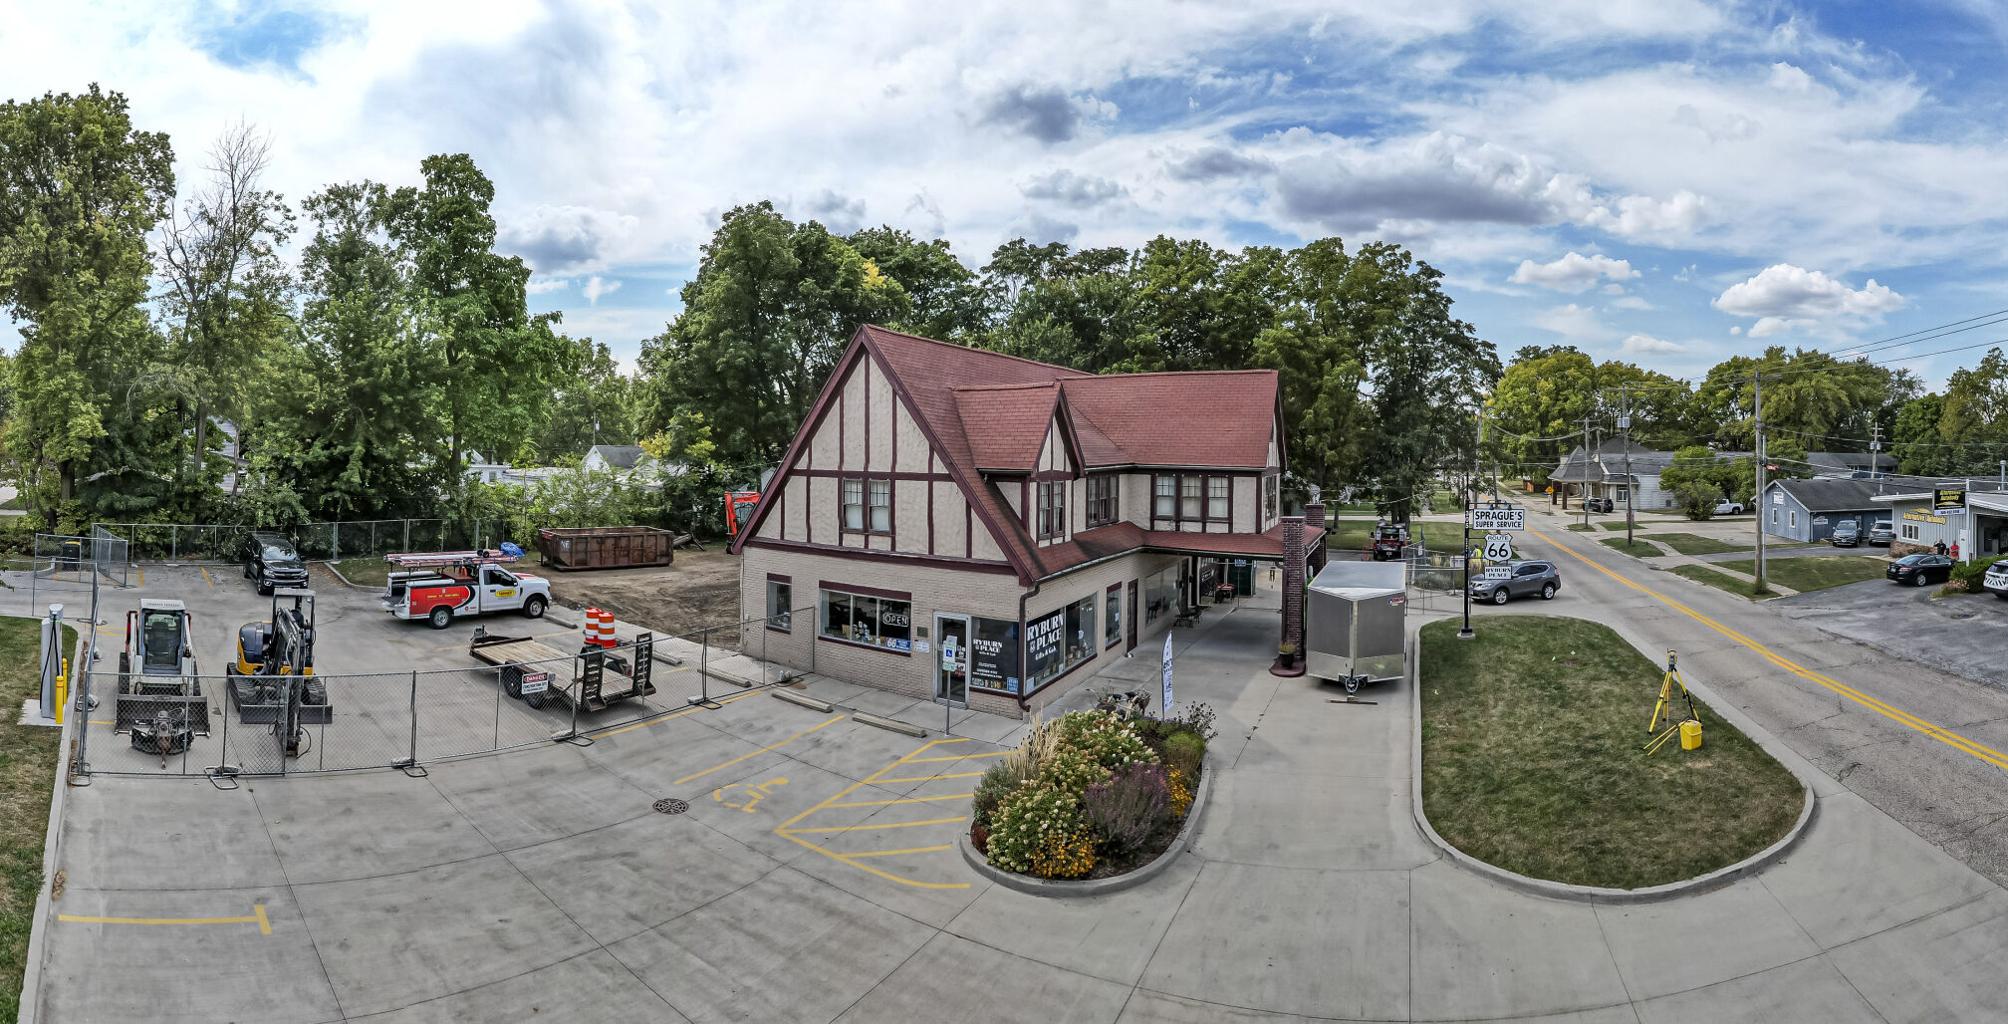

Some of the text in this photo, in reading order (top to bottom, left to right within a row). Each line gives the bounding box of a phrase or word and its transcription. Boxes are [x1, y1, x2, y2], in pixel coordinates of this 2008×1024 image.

[1475, 511, 1522, 520] SPRAGUE'S
[1488, 543, 1509, 558] 66
[884, 614, 908, 625] OPEN
[1027, 613, 1063, 641] RYBURN
[973, 638, 1003, 649] RYBURN
[1036, 628, 1062, 651] PLACE
[980, 645, 1001, 654] PLACE
